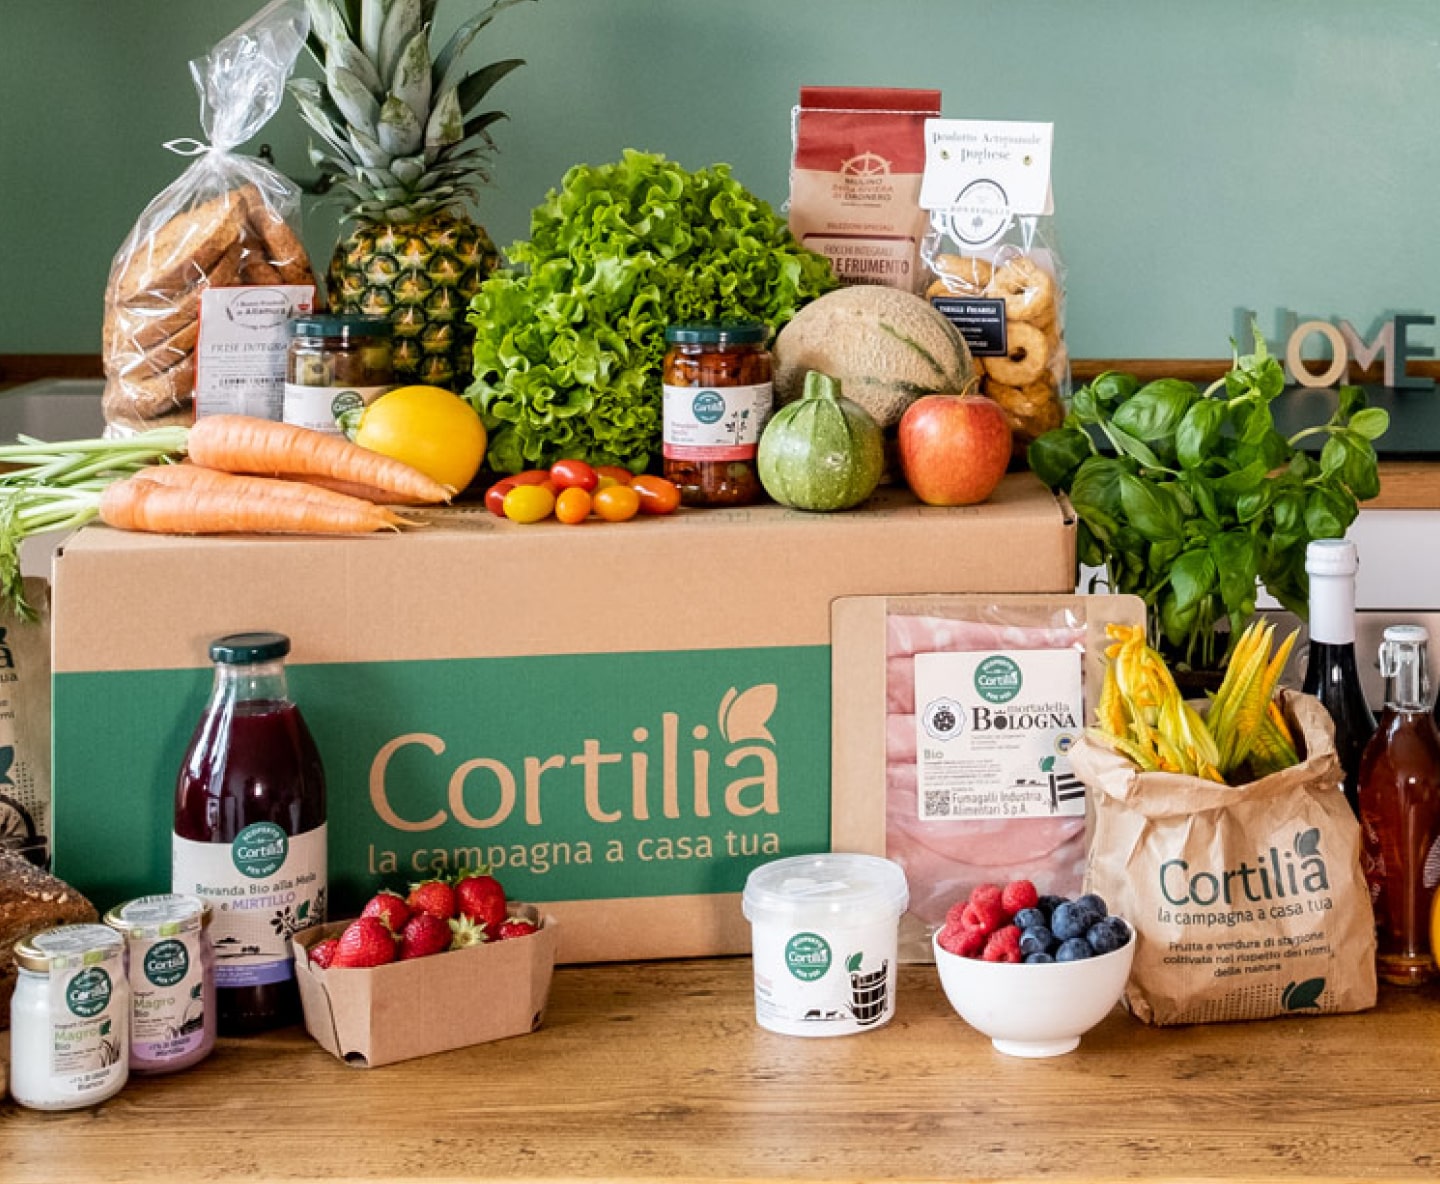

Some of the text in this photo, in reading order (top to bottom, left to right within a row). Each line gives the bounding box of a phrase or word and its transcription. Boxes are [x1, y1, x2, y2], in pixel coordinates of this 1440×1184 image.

[836, 259, 843, 273] E
[844, 259, 910, 275] FRUMENTO
[1243, 311, 1436, 392] HOME
[978, 671, 1018, 686] Cortilia
[1007, 701, 1070, 713] mortadella
[924, 749, 945, 760] Bio
[369, 712, 781, 833] Cortilia
[952, 791, 1042, 805] Fumagalli Industria
[952, 804, 1000, 816] Alimentari
[237, 840, 285, 860] Cortilia
[368, 830, 781, 875] la campagna a casa tua
[1159, 846, 1330, 906] Cortilia
[195, 883, 245, 897] Bevanda
[249, 884, 270, 894] Bio
[272, 880, 293, 893] alla
[220, 891, 297, 911] e MIRTILLO
[1157, 896, 1333, 928] la campagna a casa tua
[1169, 941, 1203, 952] Frutta
[1205, 943, 1214, 951] e
[1216, 938, 1261, 951] verdura
[1264, 936, 1275, 947] di
[1215, 954, 1235, 965] nel
[1237, 950, 1281, 964] rispetto
[1283, 947, 1302, 959] dei
[1214, 963, 1282, 978] della natura
[134, 997, 176, 1010] Magro
[54, 1027, 99, 1042] Magro
[54, 1042, 71, 1051] Bio
